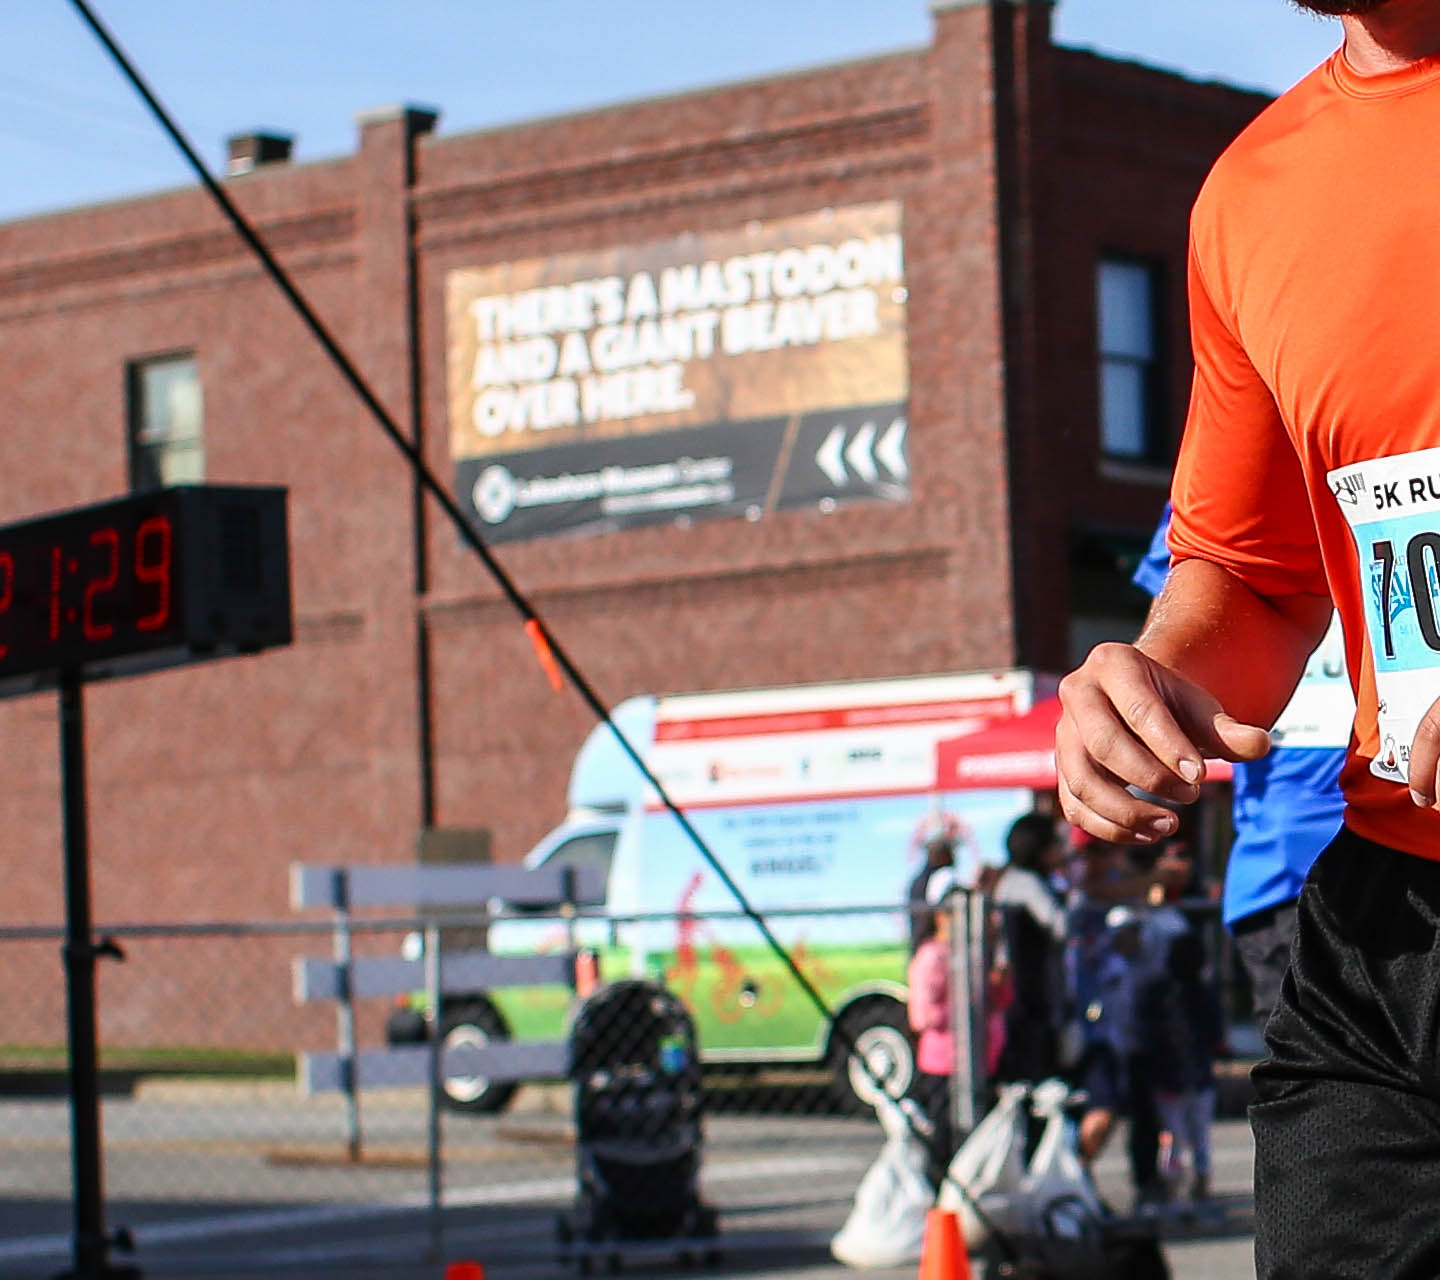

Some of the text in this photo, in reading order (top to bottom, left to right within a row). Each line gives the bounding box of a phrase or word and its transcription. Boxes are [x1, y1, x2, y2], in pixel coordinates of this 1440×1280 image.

[471, 232, 904, 343] THERE'S A MASTODON
[471, 288, 879, 389] AND A GIANT BEAVER
[472, 379, 579, 438] OVER
[1373, 481, 1404, 510] 5K
